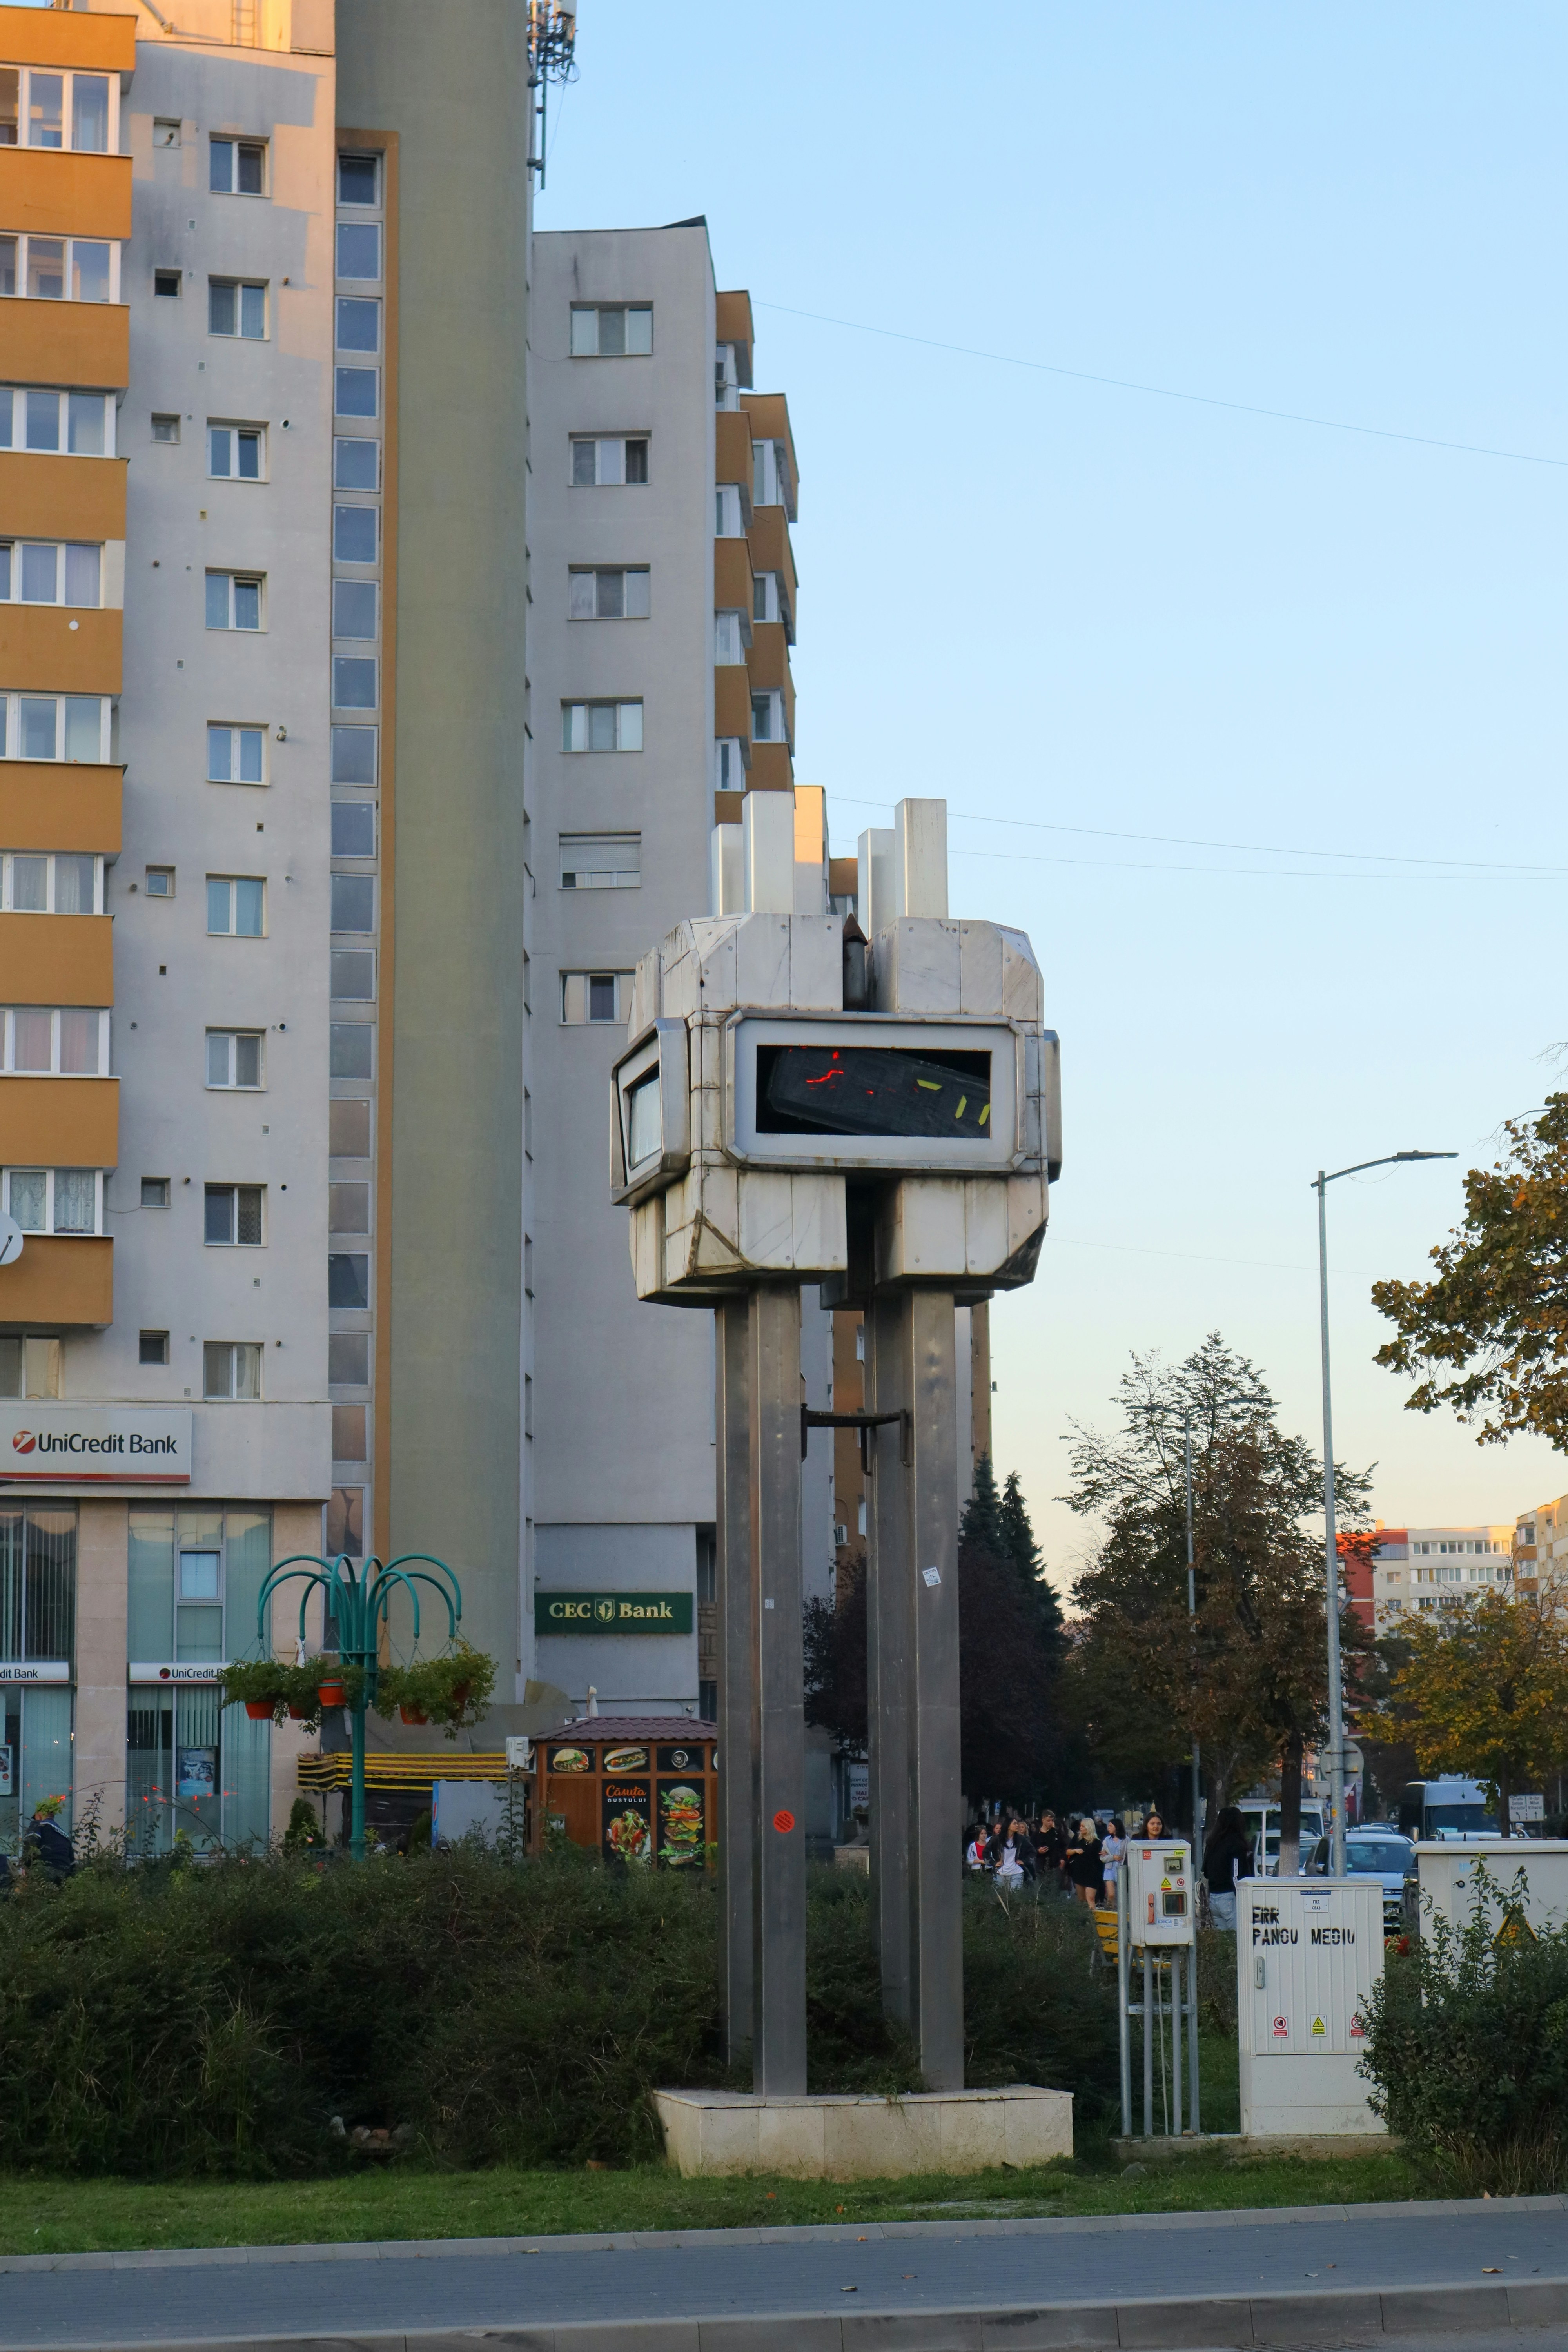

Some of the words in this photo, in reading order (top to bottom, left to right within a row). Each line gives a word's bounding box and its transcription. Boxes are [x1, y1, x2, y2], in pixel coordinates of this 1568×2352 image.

[39, 1433, 124, 1453] UniCredit
[130, 1434, 178, 1454] Bank
[549, 1602, 591, 1618] CEC
[619, 1602, 673, 1618] Bank
[14, 1668, 38, 1679] Bank
[172, 1668, 217, 1678] UniCredit
[1252, 1928, 1298, 1946] PANOU
[1311, 1928, 1355, 1945] MEDIU
